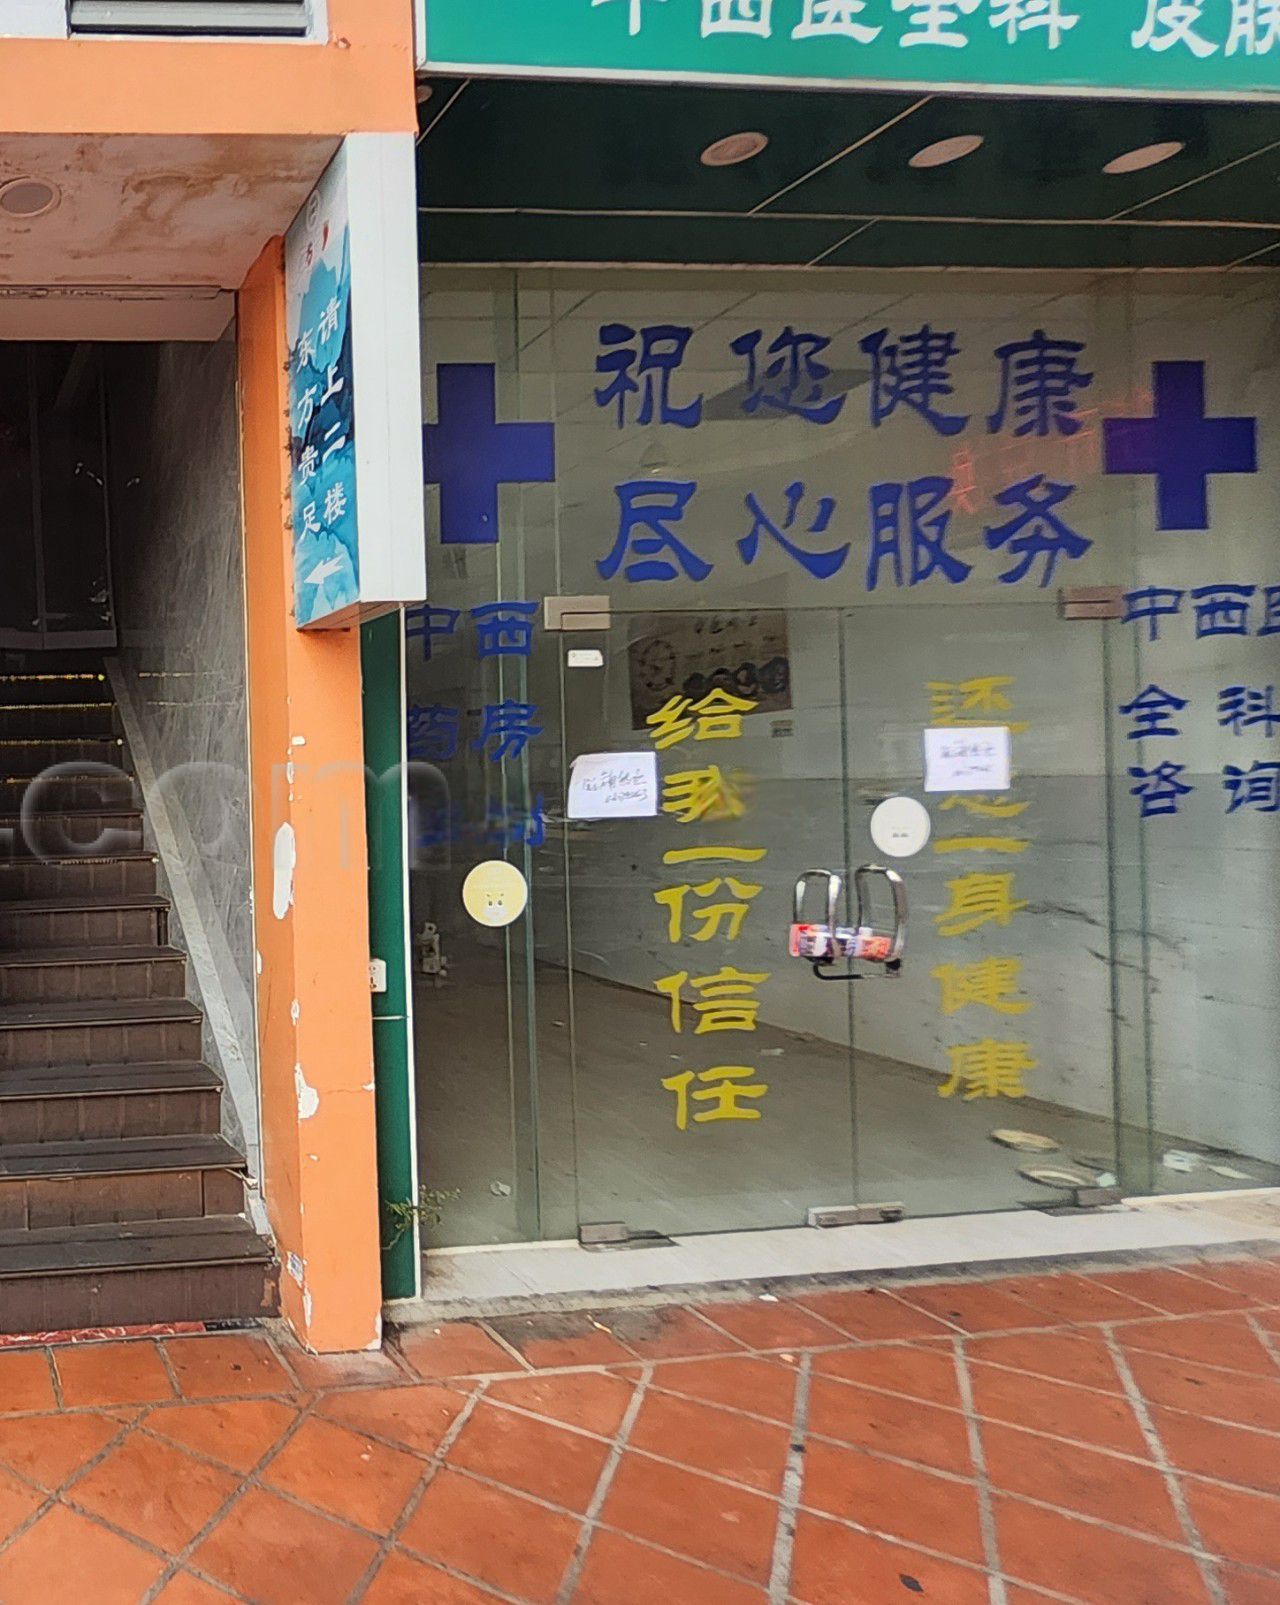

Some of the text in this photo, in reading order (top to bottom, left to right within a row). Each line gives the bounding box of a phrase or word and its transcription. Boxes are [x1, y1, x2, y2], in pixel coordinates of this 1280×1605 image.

[317, 295, 347, 527] 请上二楼
[594, 323, 1095, 438] 祝您健康
[596, 474, 1093, 589] 尽心服务
[406, 602, 539, 662] 中西
[1119, 684, 1280, 739] 全科
[1126, 760, 1280, 818] 咨询
